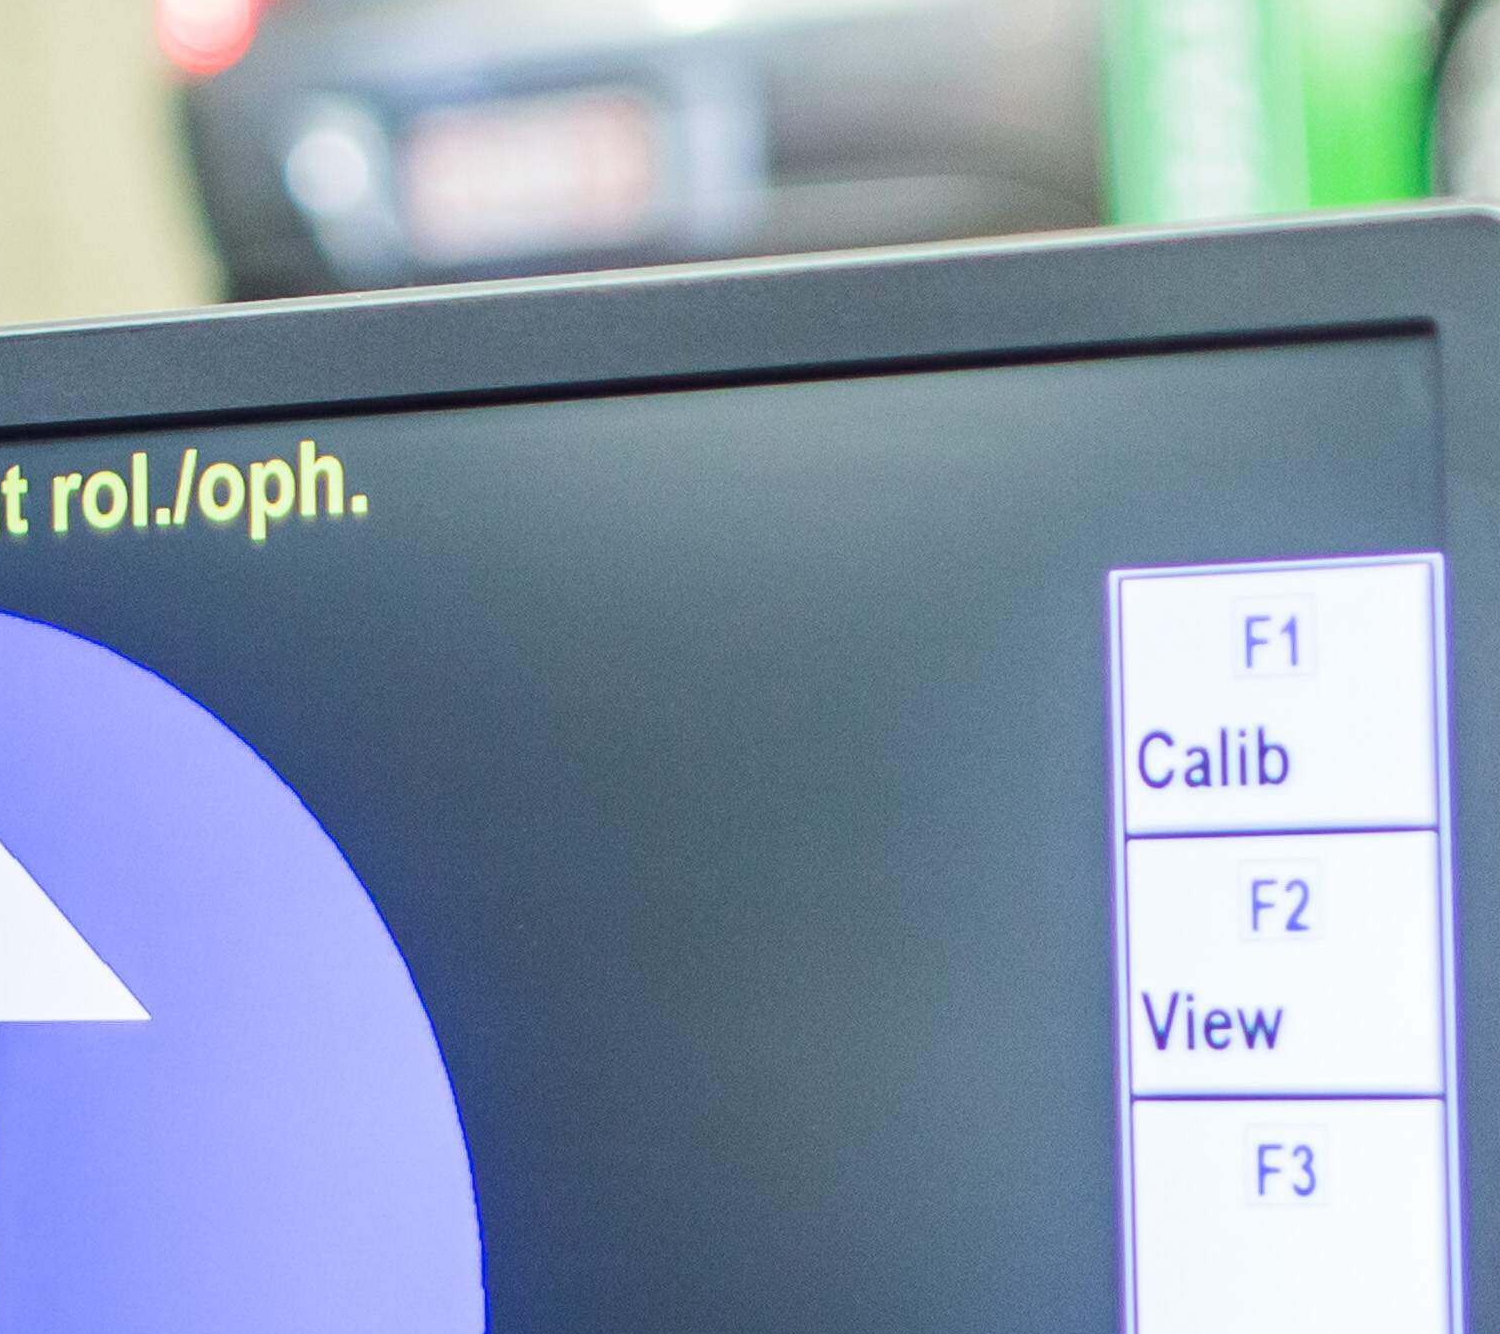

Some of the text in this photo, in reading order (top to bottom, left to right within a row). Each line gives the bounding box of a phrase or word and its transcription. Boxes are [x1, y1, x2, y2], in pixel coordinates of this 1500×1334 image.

[50, 438, 370, 543] rol./oph.
[1243, 614, 1300, 670] F1
[1136, 724, 1292, 791] Calib
[1250, 877, 1311, 934] F2
[1140, 989, 1285, 1052] View
[1255, 1142, 1318, 1199] F3
